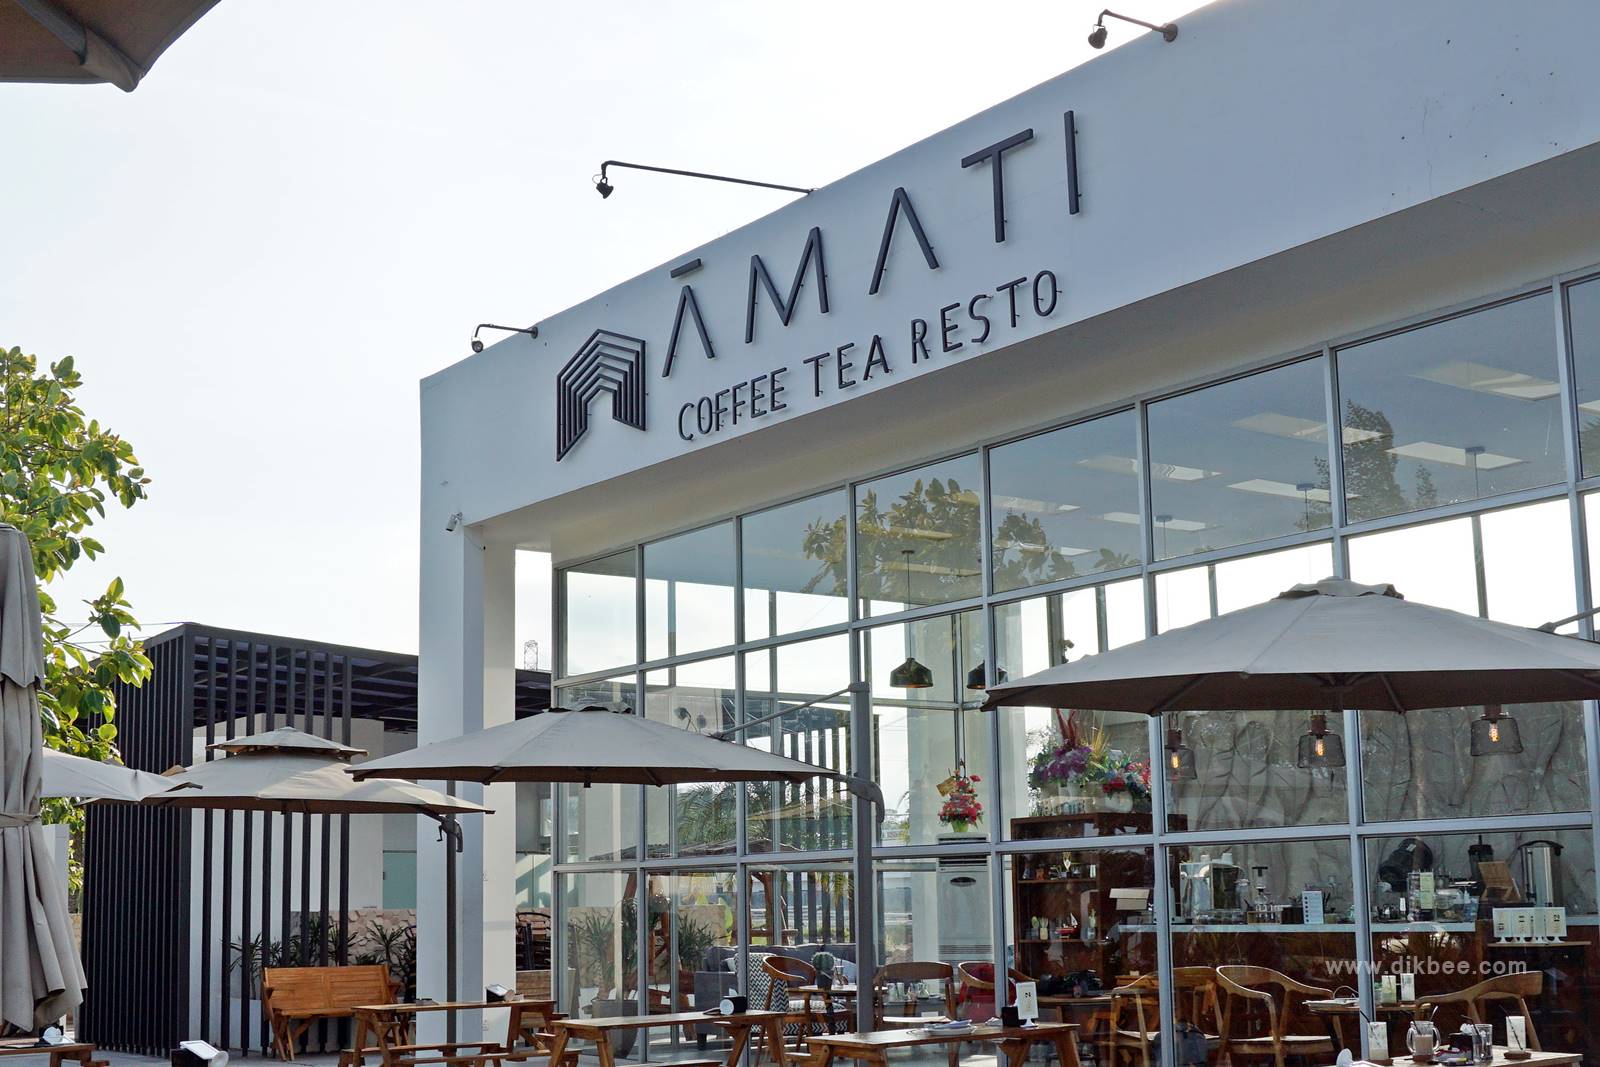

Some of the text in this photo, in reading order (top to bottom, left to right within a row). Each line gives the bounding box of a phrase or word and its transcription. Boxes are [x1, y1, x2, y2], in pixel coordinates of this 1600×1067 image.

[678, 270, 1057, 440] COFFEE TEA RESTO
